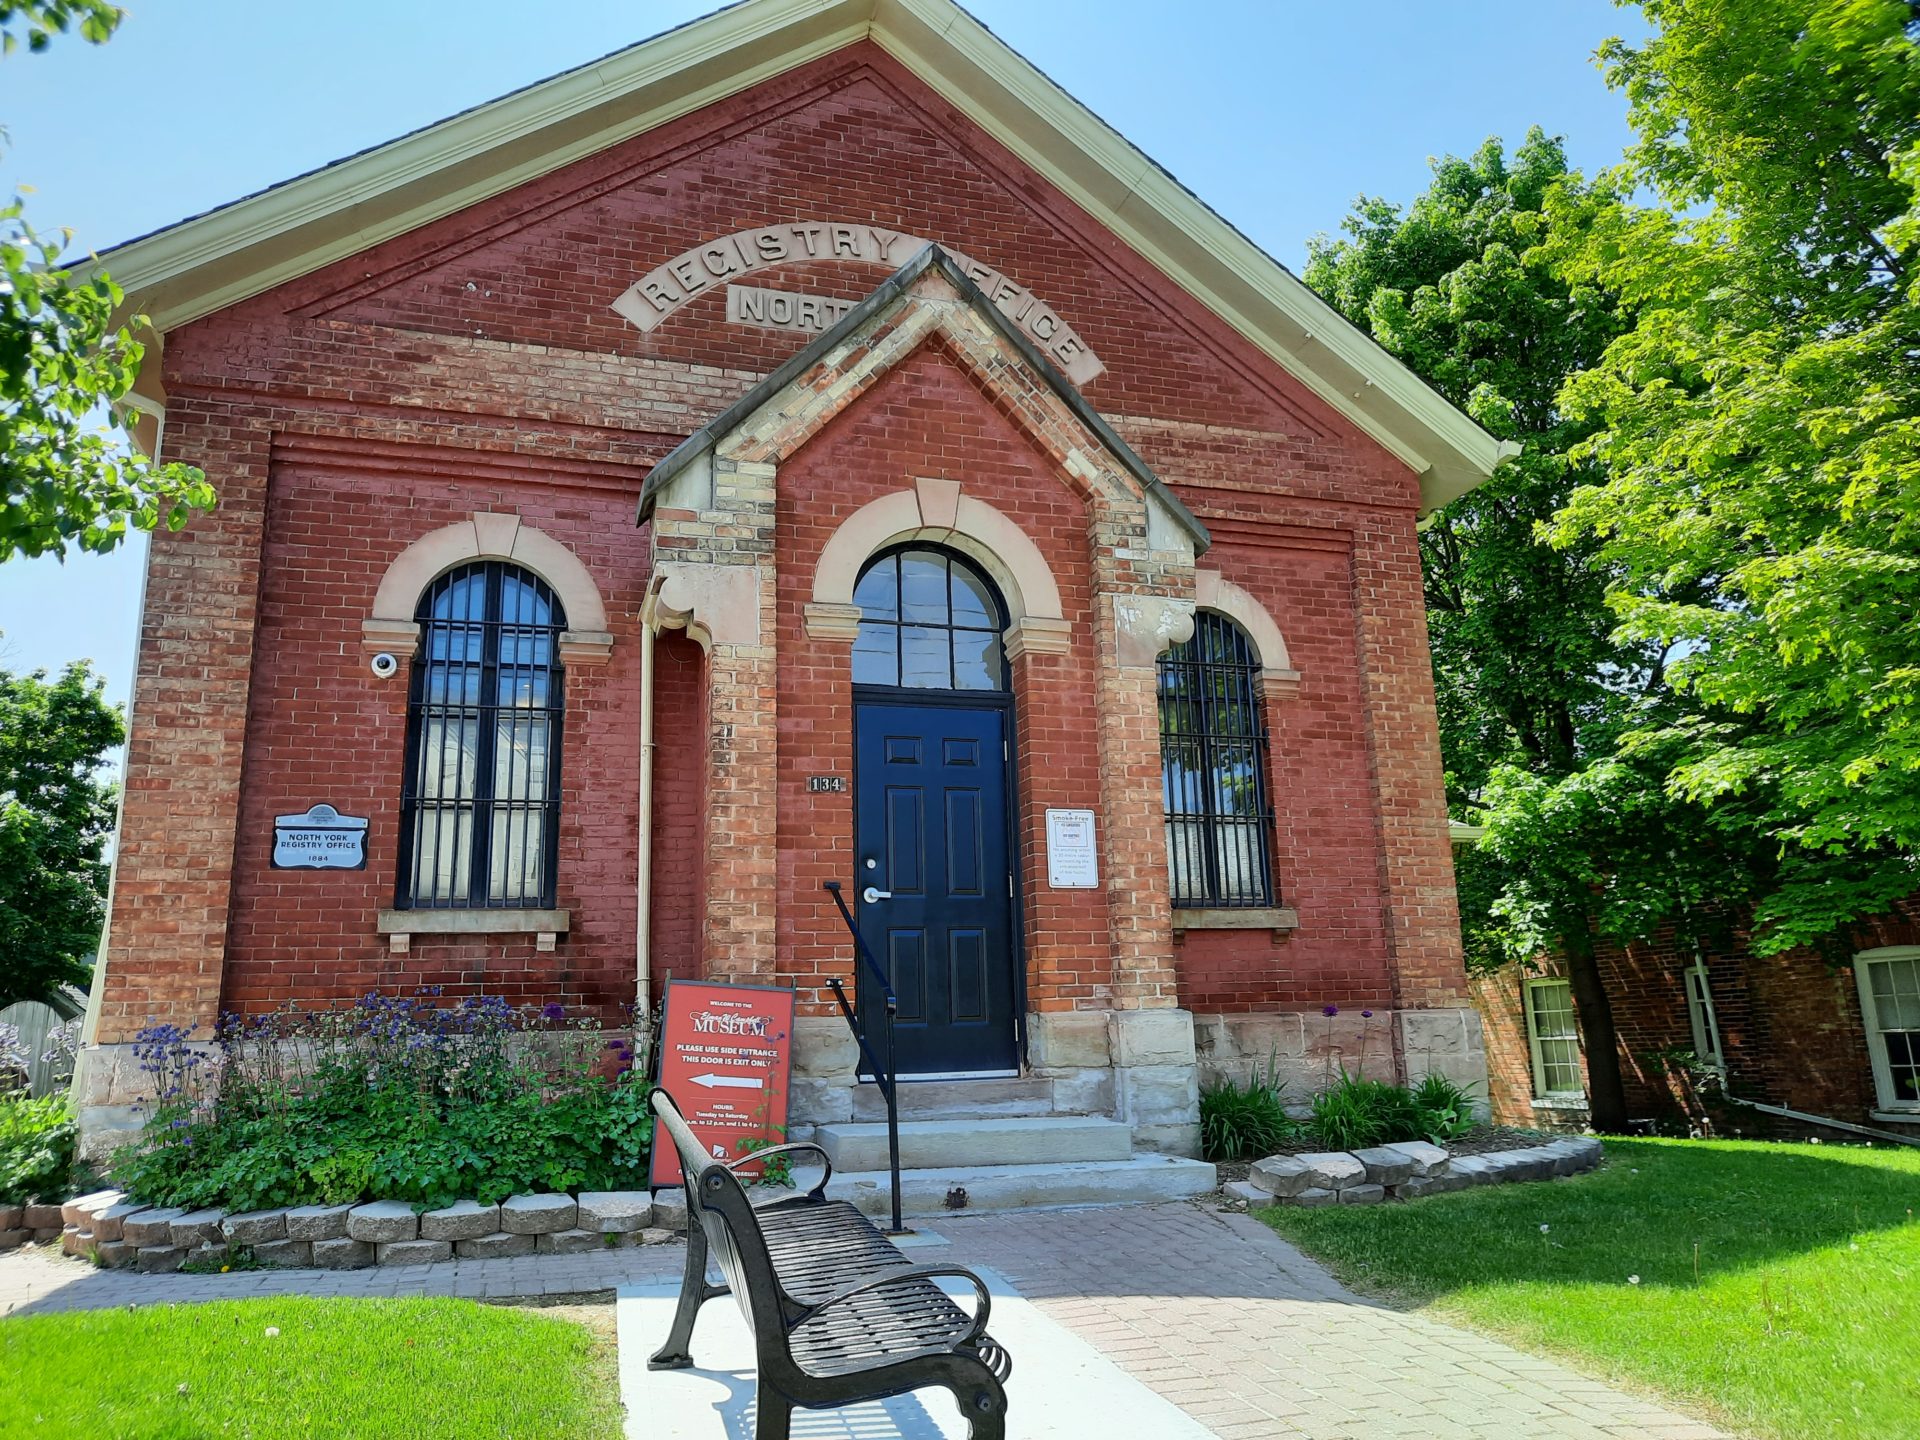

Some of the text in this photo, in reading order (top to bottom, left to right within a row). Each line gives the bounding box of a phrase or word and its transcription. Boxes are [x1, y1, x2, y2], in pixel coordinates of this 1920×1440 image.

[638, 226, 1085, 365] REGISTRY FFICE
[739, 289, 848, 330] NORT
[812, 778, 840, 791] 134
[693, 1019, 766, 1036] MUSEUM
[677, 1044, 703, 1052] PLEASE
[739, 1048, 777, 1057] ENTRANCE
[682, 1055, 699, 1063] THIS
[701, 1057, 723, 1065] DOOR
